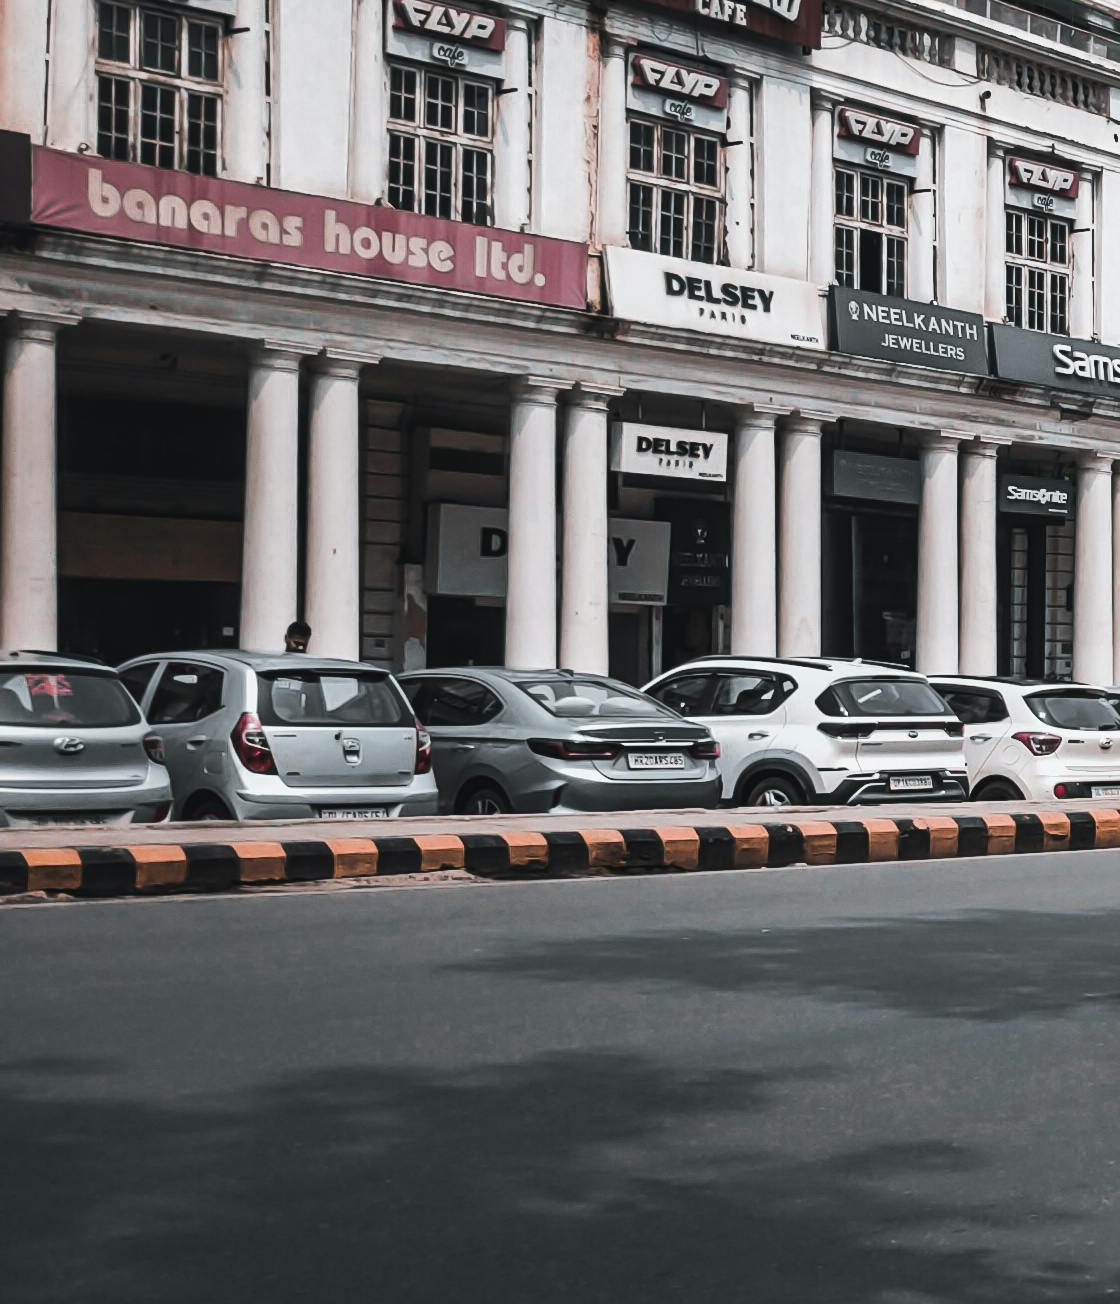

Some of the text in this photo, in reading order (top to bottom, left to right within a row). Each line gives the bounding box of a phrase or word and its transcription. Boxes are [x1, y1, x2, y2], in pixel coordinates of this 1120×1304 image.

[438, 44, 464, 66] cafe
[640, 59, 720, 97] FLYP
[845, 111, 915, 146] FLYP
[1015, 161, 1074, 191] FLYP
[87, 168, 547, 287] banaras house ltd.
[664, 271, 774, 313] DELSEY
[699, 307, 747, 325] PARIS
[863, 303, 978, 341] NEELKANTH
[881, 334, 965, 361] JEWELLERS
[636, 436, 714, 460] DELSEY
[1006, 485, 1068, 504] Samsonite
